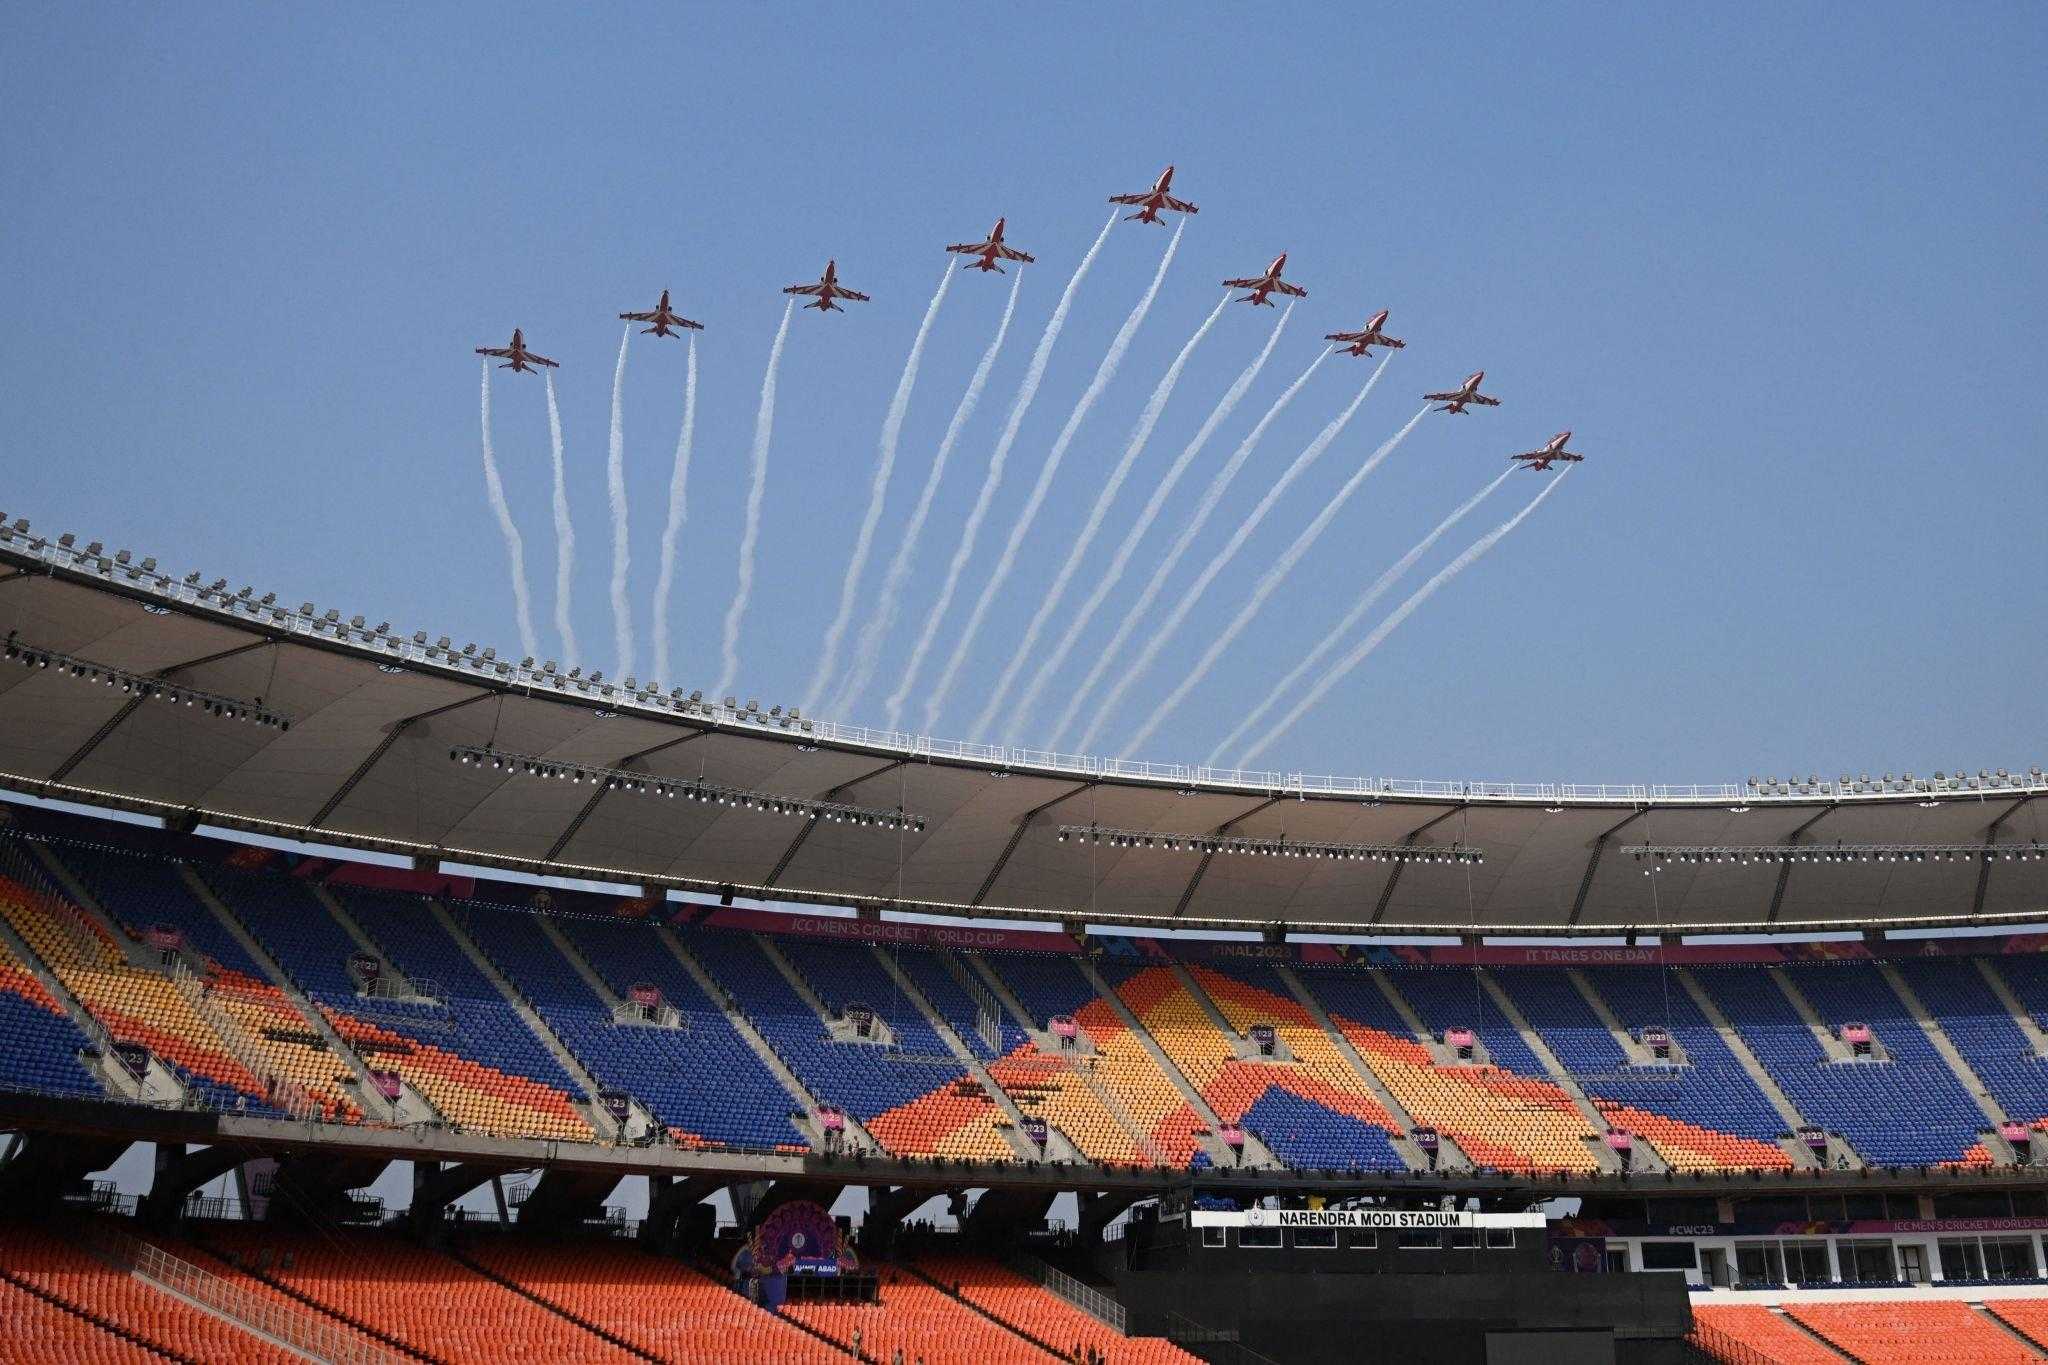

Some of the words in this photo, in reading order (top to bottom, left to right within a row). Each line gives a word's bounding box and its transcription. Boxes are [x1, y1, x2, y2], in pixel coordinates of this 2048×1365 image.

[792, 918, 813, 931] ICC
[816, 920, 859, 935] MEN'S
[863, 923, 920, 939] CRICKET
[977, 932, 1005, 945] CUP
[1213, 944, 1254, 957] FINAL
[1526, 949, 1539, 961] IT
[1542, 949, 1586, 961] TAKES
[1591, 950, 1623, 961] ONE
[1624, 950, 1656, 961] DAY
[1413, 1134, 1436, 1142] 2023
[1280, 1212, 1356, 1226] NARENDRA
[1361, 1212, 1396, 1226] MODI
[1400, 1212, 1460, 1226] STADIUM
[1894, 1221, 1908, 1231] ICC
[1912, 1220, 1943, 1231] MEN'S
[1945, 1219, 1988, 1230] CRICKET
[1992, 1218, 2030, 1229] WORLD
[2032, 1217, 2048, 1228] CU
[1669, 1225, 1715, 1235] #CWC23
